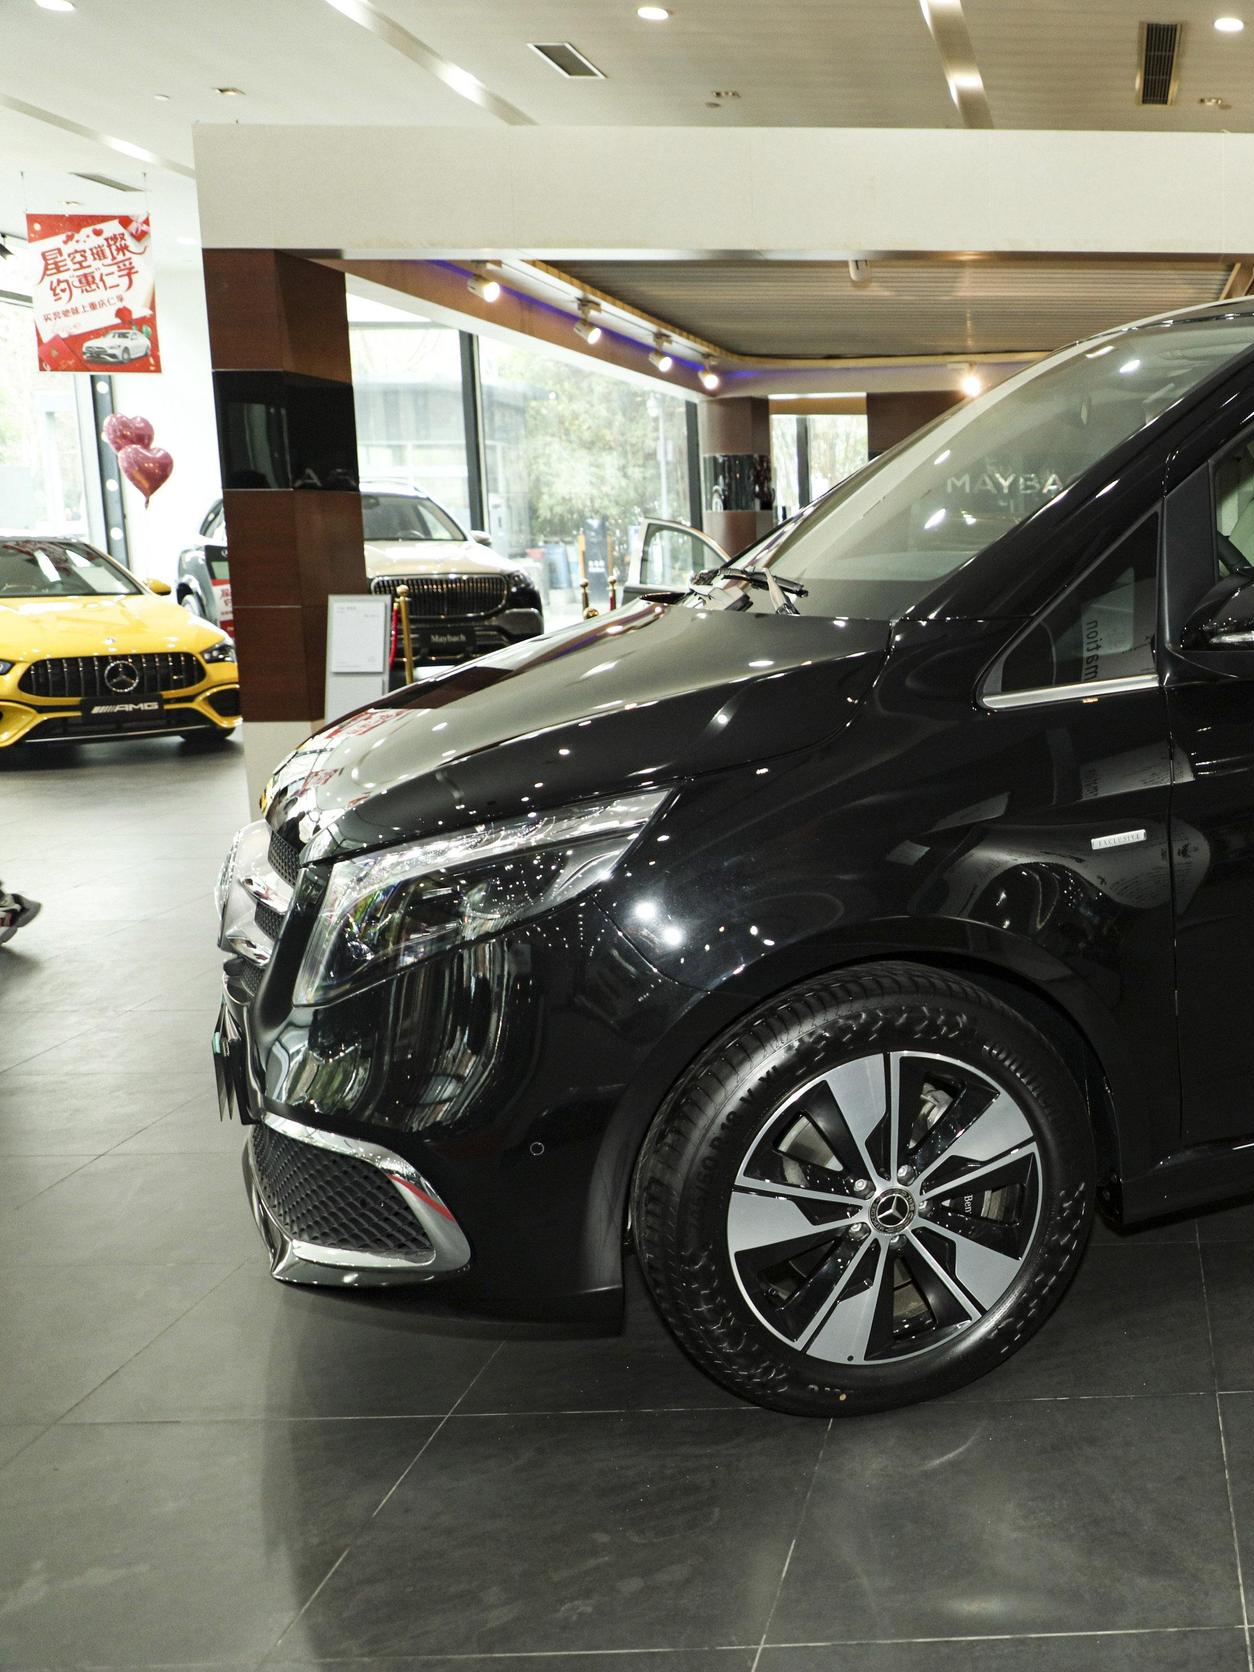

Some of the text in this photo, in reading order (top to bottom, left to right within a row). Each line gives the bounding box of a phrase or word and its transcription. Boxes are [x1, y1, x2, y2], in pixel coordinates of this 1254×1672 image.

[38, 233, 138, 284] 星空璀璨
[430, 633, 466, 645] Maybach
[114, 702, 159, 712] AMG
[964, 1195, 974, 1213] Ben
